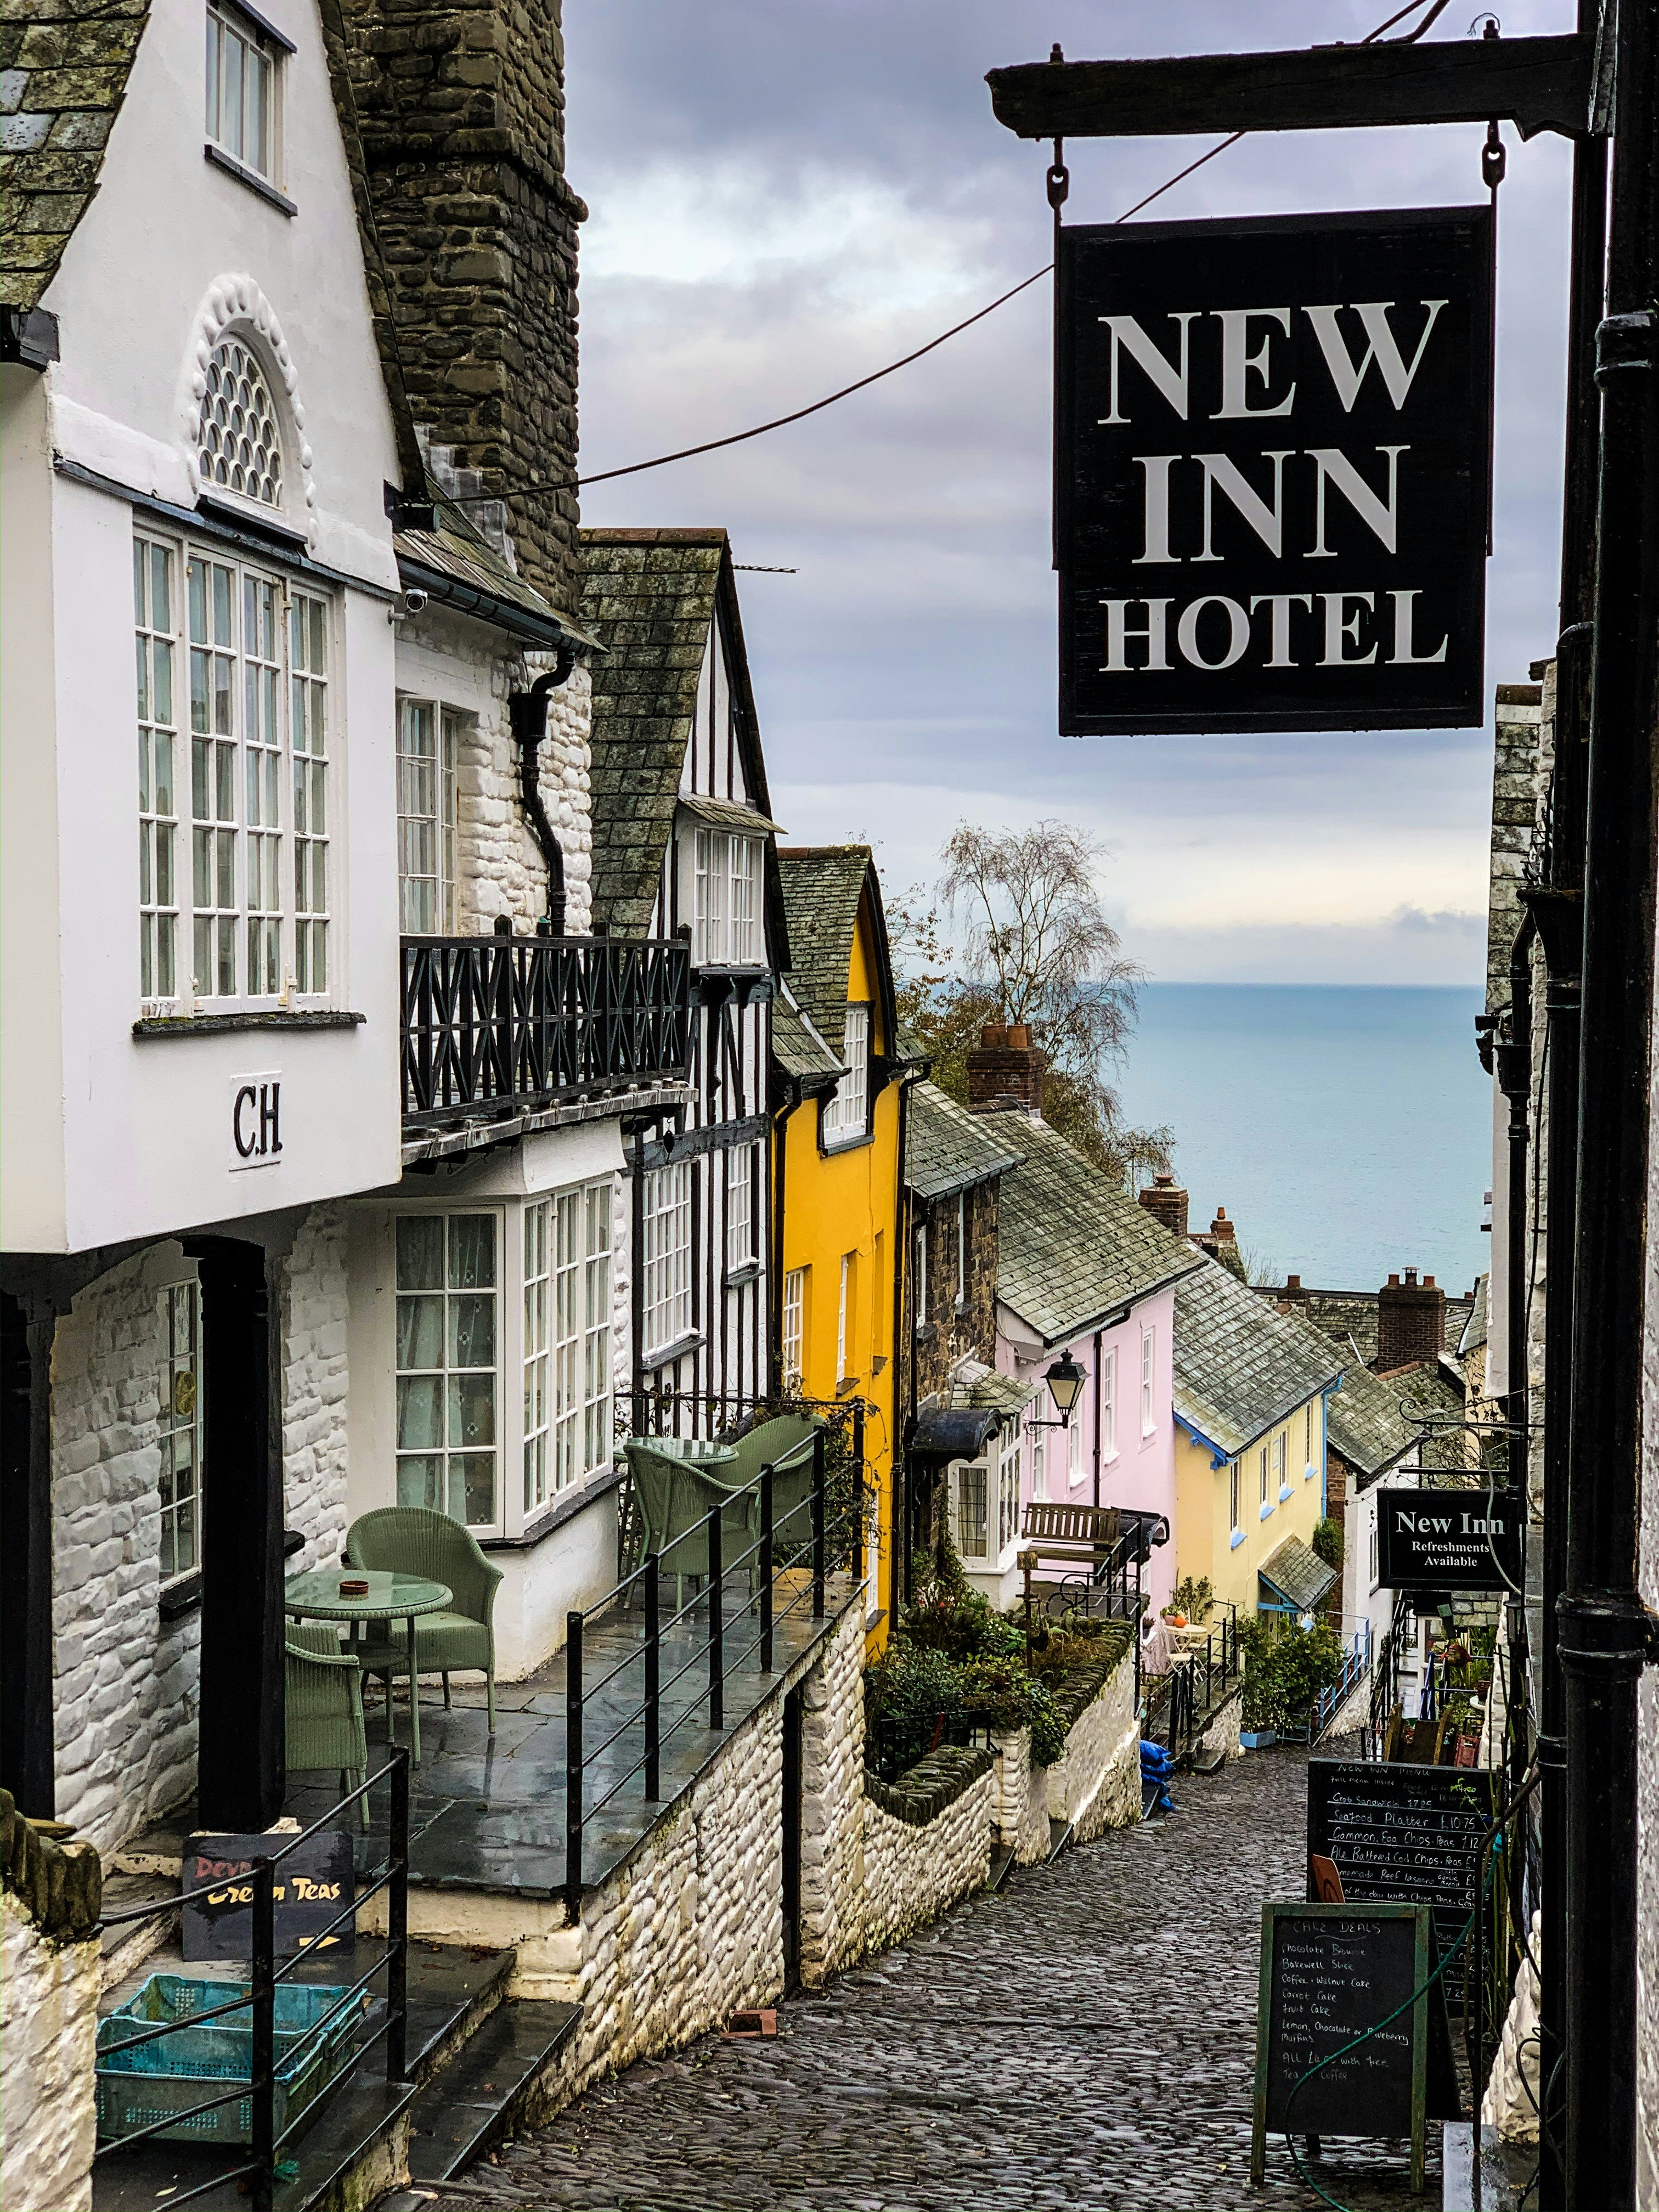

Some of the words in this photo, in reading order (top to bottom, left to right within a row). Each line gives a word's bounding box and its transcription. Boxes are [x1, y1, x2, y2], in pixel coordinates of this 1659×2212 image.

[1098, 300, 1449, 424] NEW
[1132, 445, 1411, 563] INN
[1099, 590, 1448, 672] HOTEL
[1396, 1511, 1453, 1534] New
[1460, 1513, 1505, 1534] Inn
[1412, 1541, 1490, 1553] Refreshments
[1424, 1556, 1477, 1567] Available
[1385, 1812, 1429, 1827] Platter
[1331, 1845, 1348, 1859] Ale
[1352, 1846, 1390, 1862] Battered
[195, 1857, 252, 1878] Devo
[1380, 1869, 1401, 1881] Beef
[292, 1877, 341, 1901] Teas
[1339, 1921, 1381, 1934] DEALS
[1282, 1943, 1324, 1954] Chocolate
[1282, 1957, 1325, 1970] Bakewell
[1282, 1973, 1308, 1985] Coffee
[1351, 1978, 1371, 1989] Cake
[1317, 1991, 1336, 2002] Cake
[1311, 2004, 1331, 2016] Cake
[1314, 2021, 1350, 2034] Chocolate
